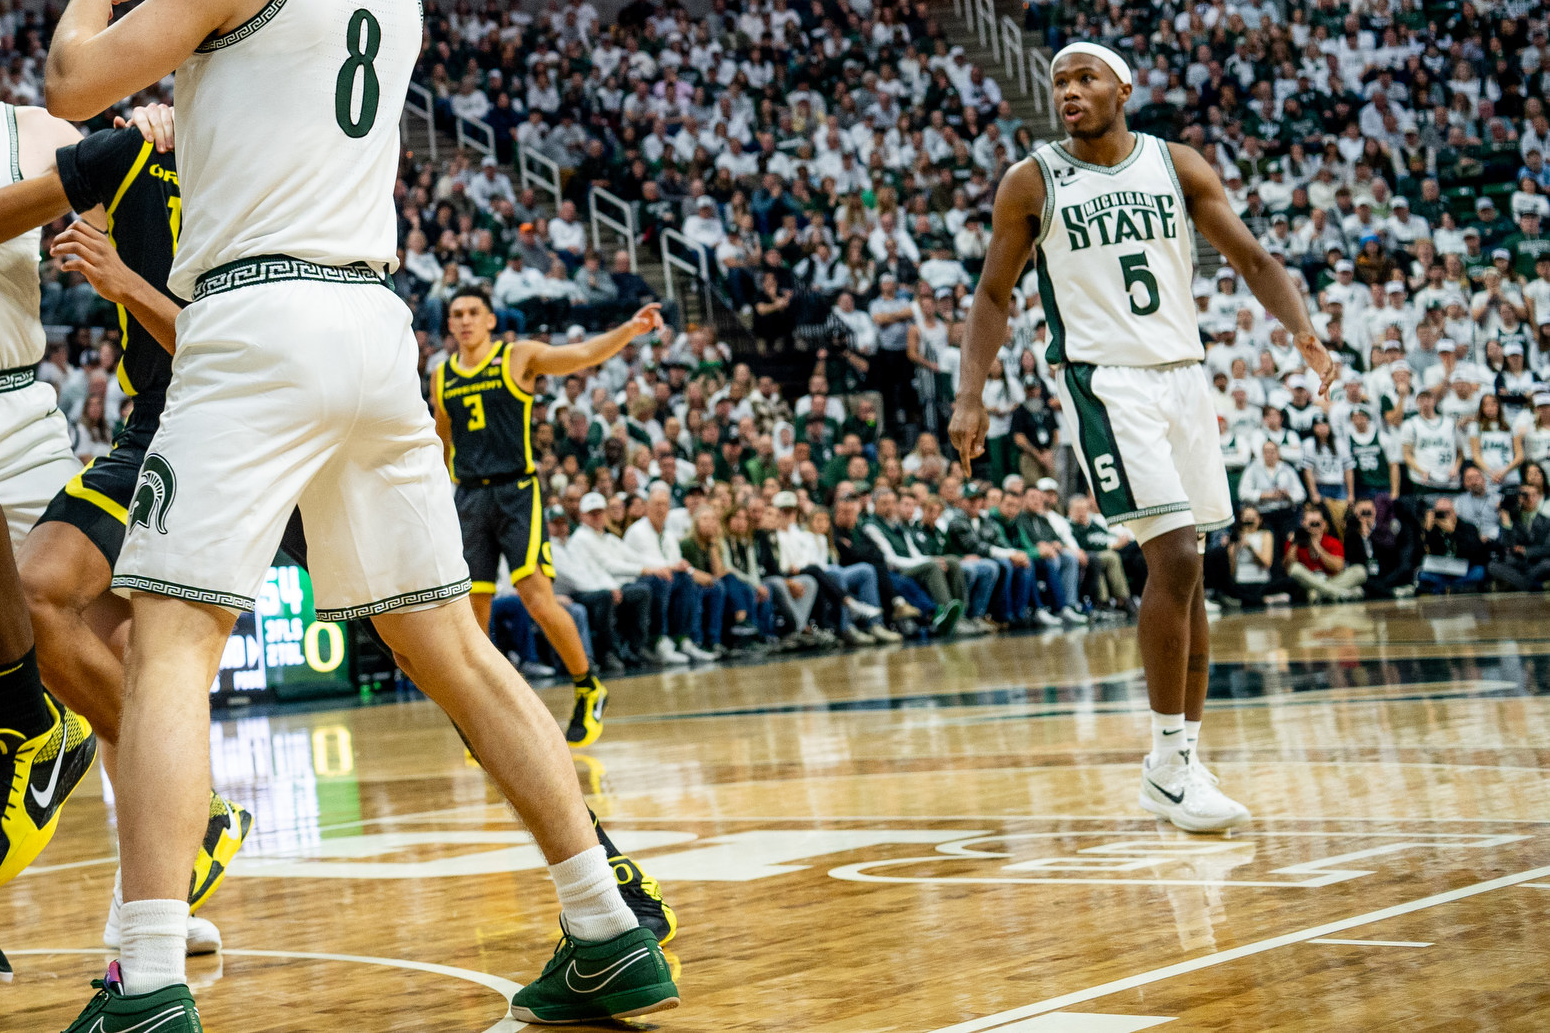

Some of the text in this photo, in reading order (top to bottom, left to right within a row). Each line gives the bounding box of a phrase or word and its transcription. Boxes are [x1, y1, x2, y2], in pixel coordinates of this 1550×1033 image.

[335, 8, 381, 138] 8
[1061, 194, 1177, 252] STATE
[1083, 191, 1155, 217] MICHIGAN
[1119, 251, 1161, 316] 5
[462, 393, 486, 432] 3
[1093, 453, 1121, 493] S
[256, 566, 304, 617] 54
